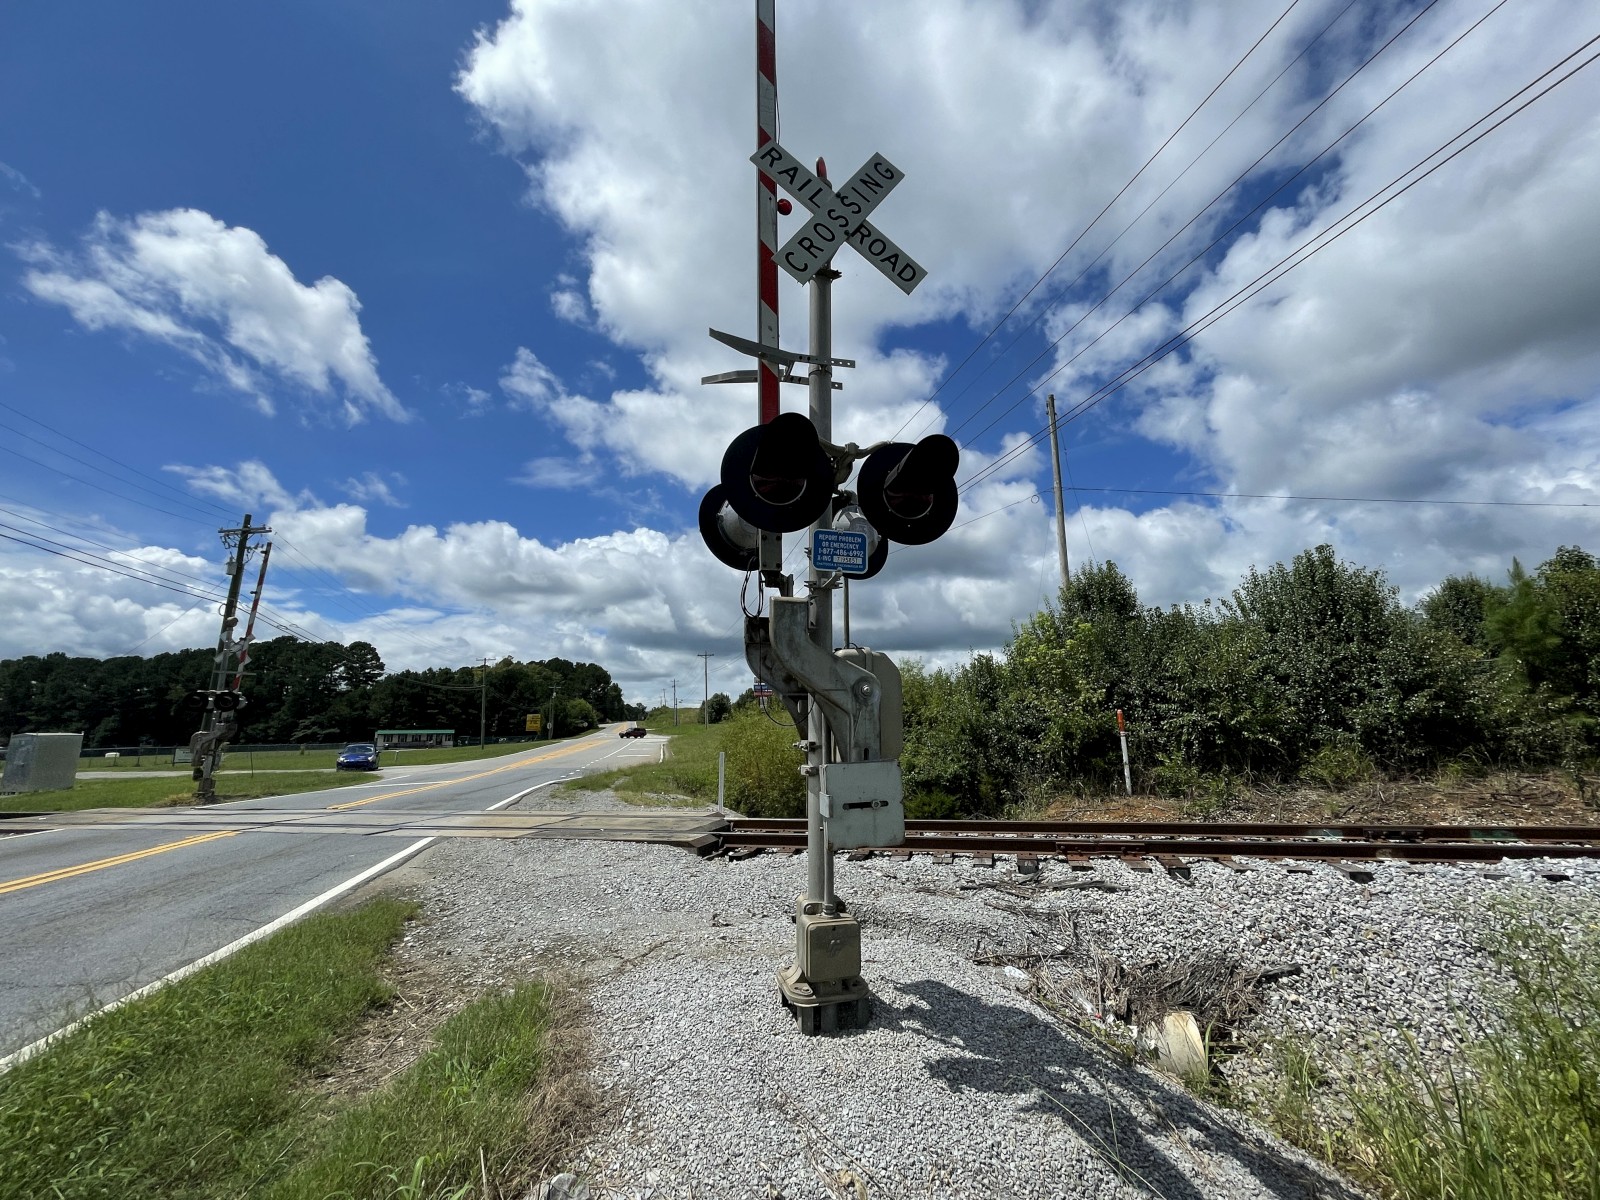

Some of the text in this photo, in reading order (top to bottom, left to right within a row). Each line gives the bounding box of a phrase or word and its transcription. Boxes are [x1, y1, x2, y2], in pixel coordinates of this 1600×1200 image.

[760, 146, 917, 283] RAIL ROAD
[785, 161, 895, 273] CROSSING
[819, 548, 864, 557] 1-877-486-6992
